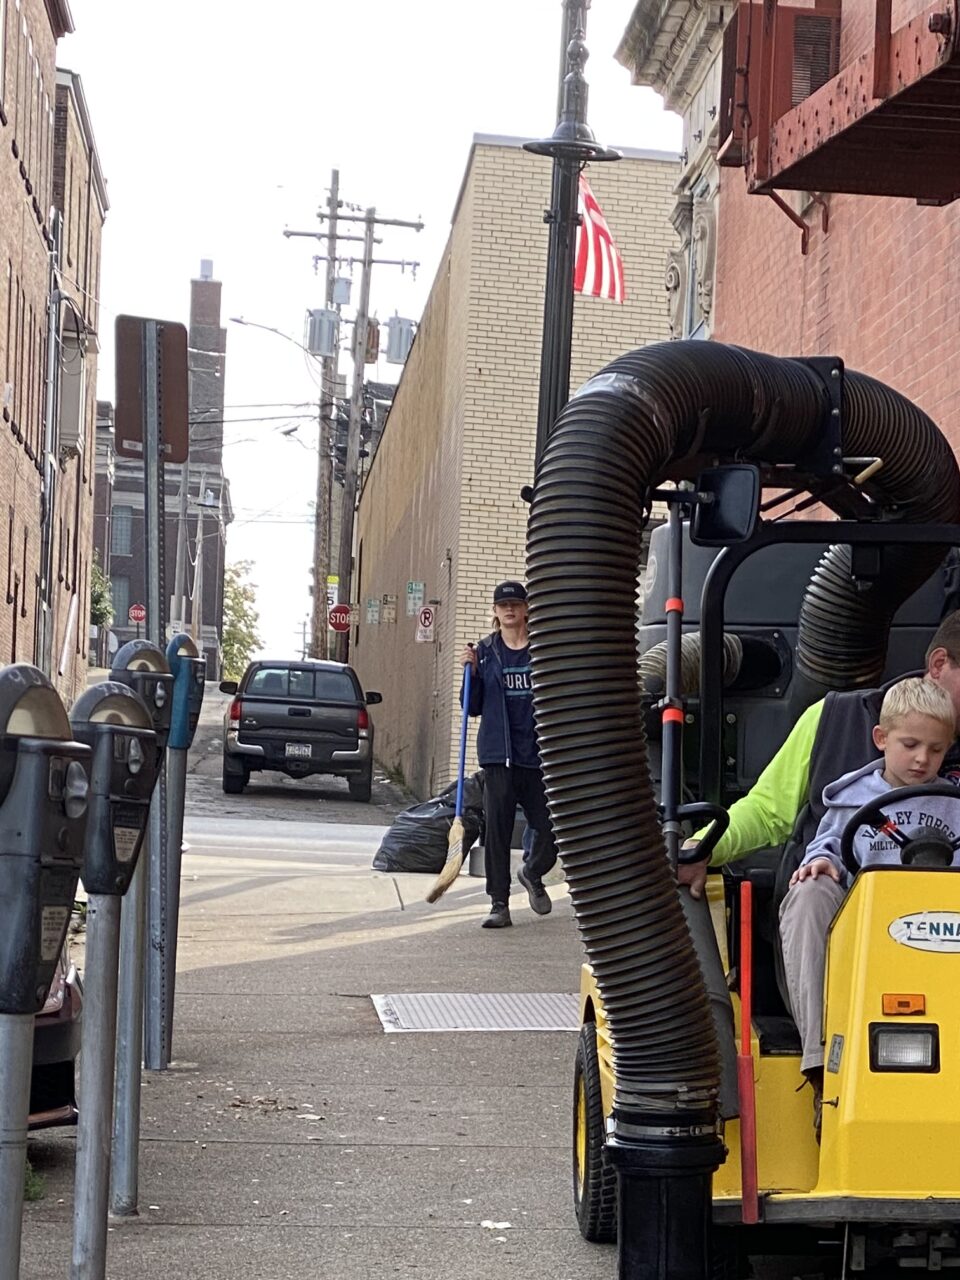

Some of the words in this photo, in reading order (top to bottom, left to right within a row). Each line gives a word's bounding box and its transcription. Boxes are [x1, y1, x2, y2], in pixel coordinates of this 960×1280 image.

[130, 609, 146, 617] STOP
[503, 673, 535, 689] URL
[861, 811, 912, 839] VALEY
[918, 812, 956, 839] FORGE
